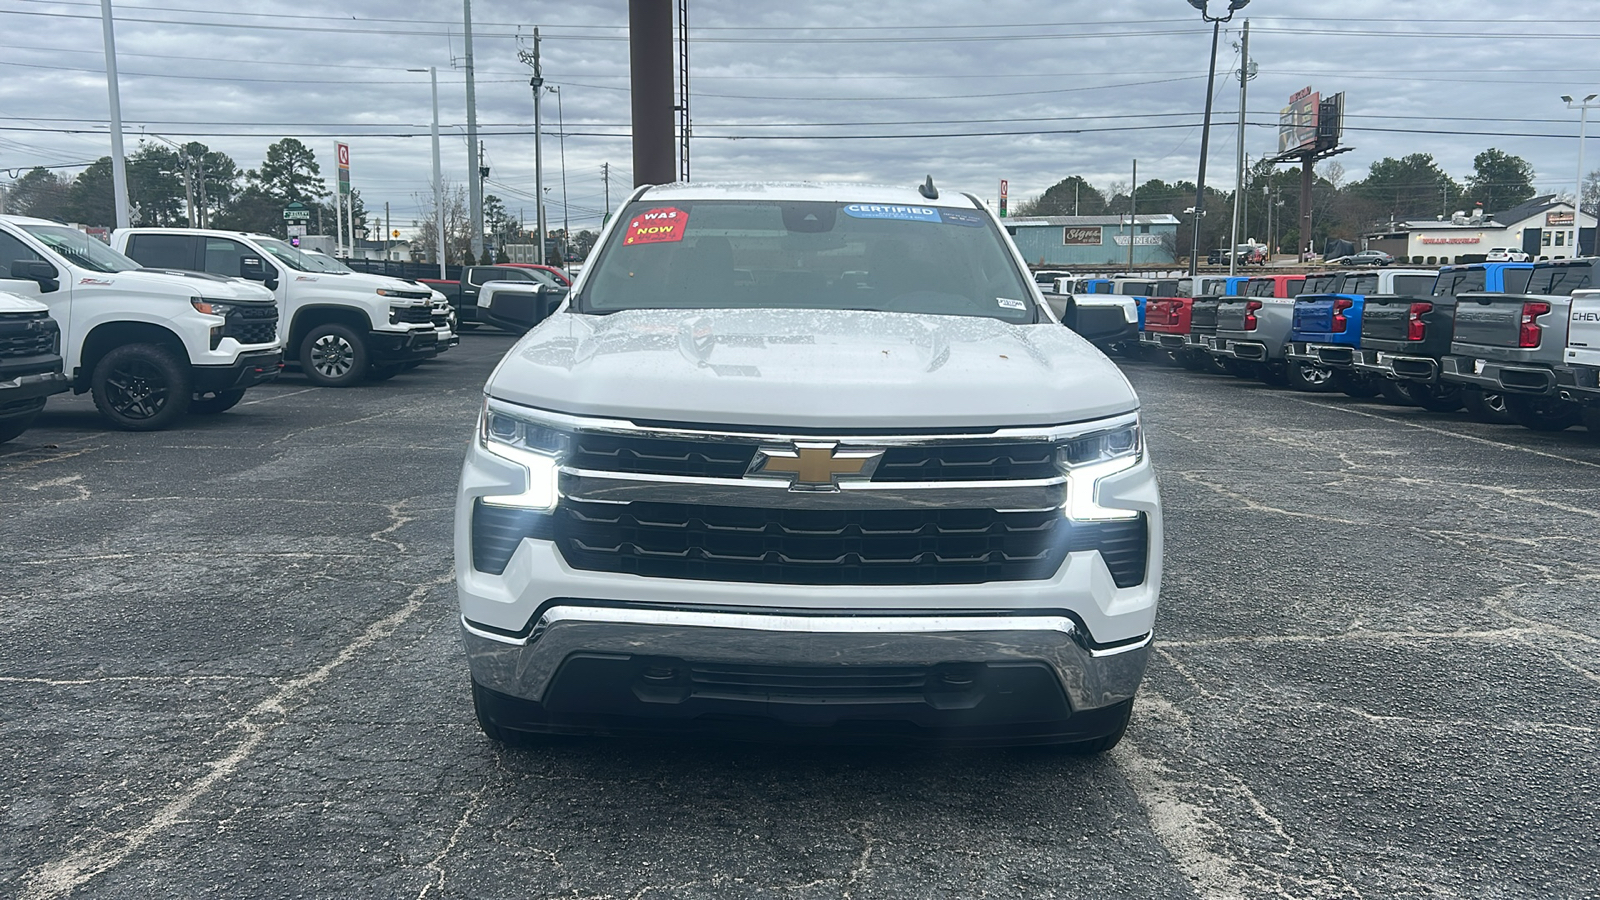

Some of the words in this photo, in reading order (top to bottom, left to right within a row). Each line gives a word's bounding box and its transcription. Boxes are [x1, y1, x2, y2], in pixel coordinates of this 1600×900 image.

[848, 205, 933, 215] CERTIFIED
[645, 212, 677, 220] WAS
[637, 226, 674, 235] NOW
